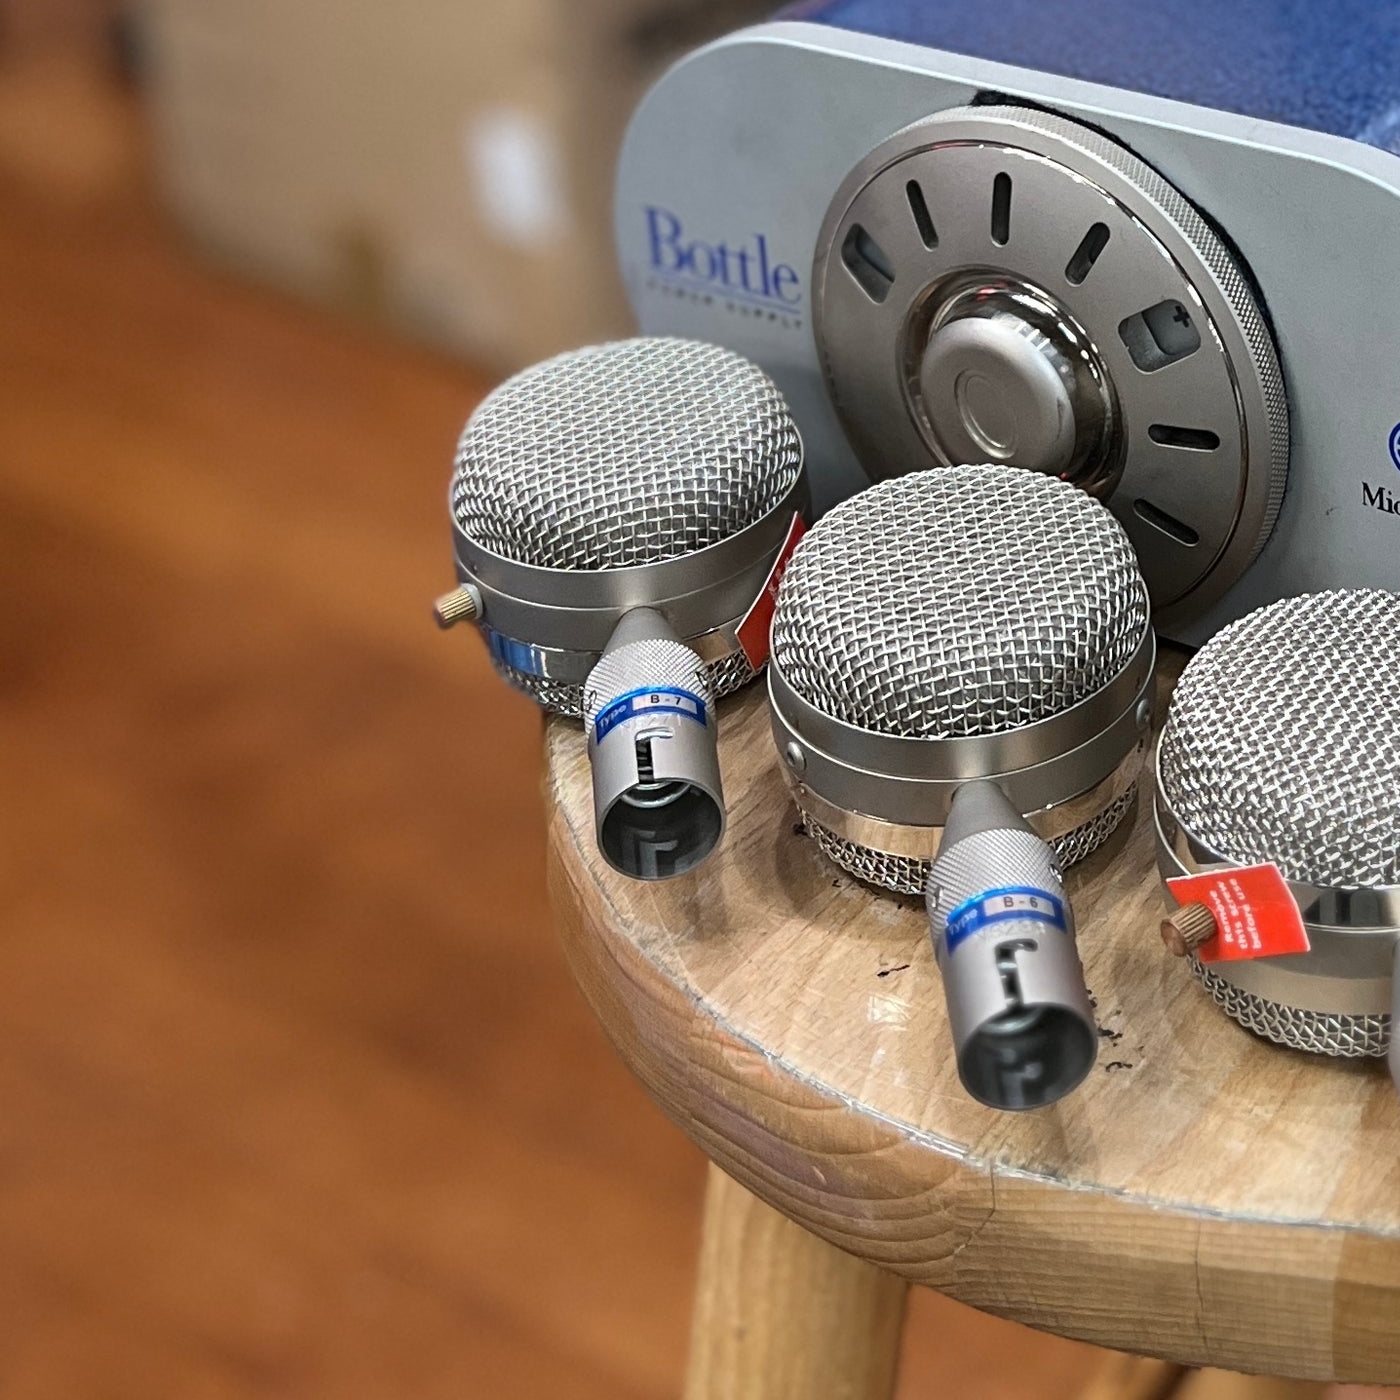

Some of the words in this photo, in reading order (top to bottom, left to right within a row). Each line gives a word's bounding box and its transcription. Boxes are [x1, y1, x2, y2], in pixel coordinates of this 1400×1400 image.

[643, 204, 802, 305] Bottle
[1217, 881, 1239, 917] screw
[1229, 878, 1245, 900] use
[1209, 890, 1234, 943] Remove
[1234, 921, 1248, 949] this
